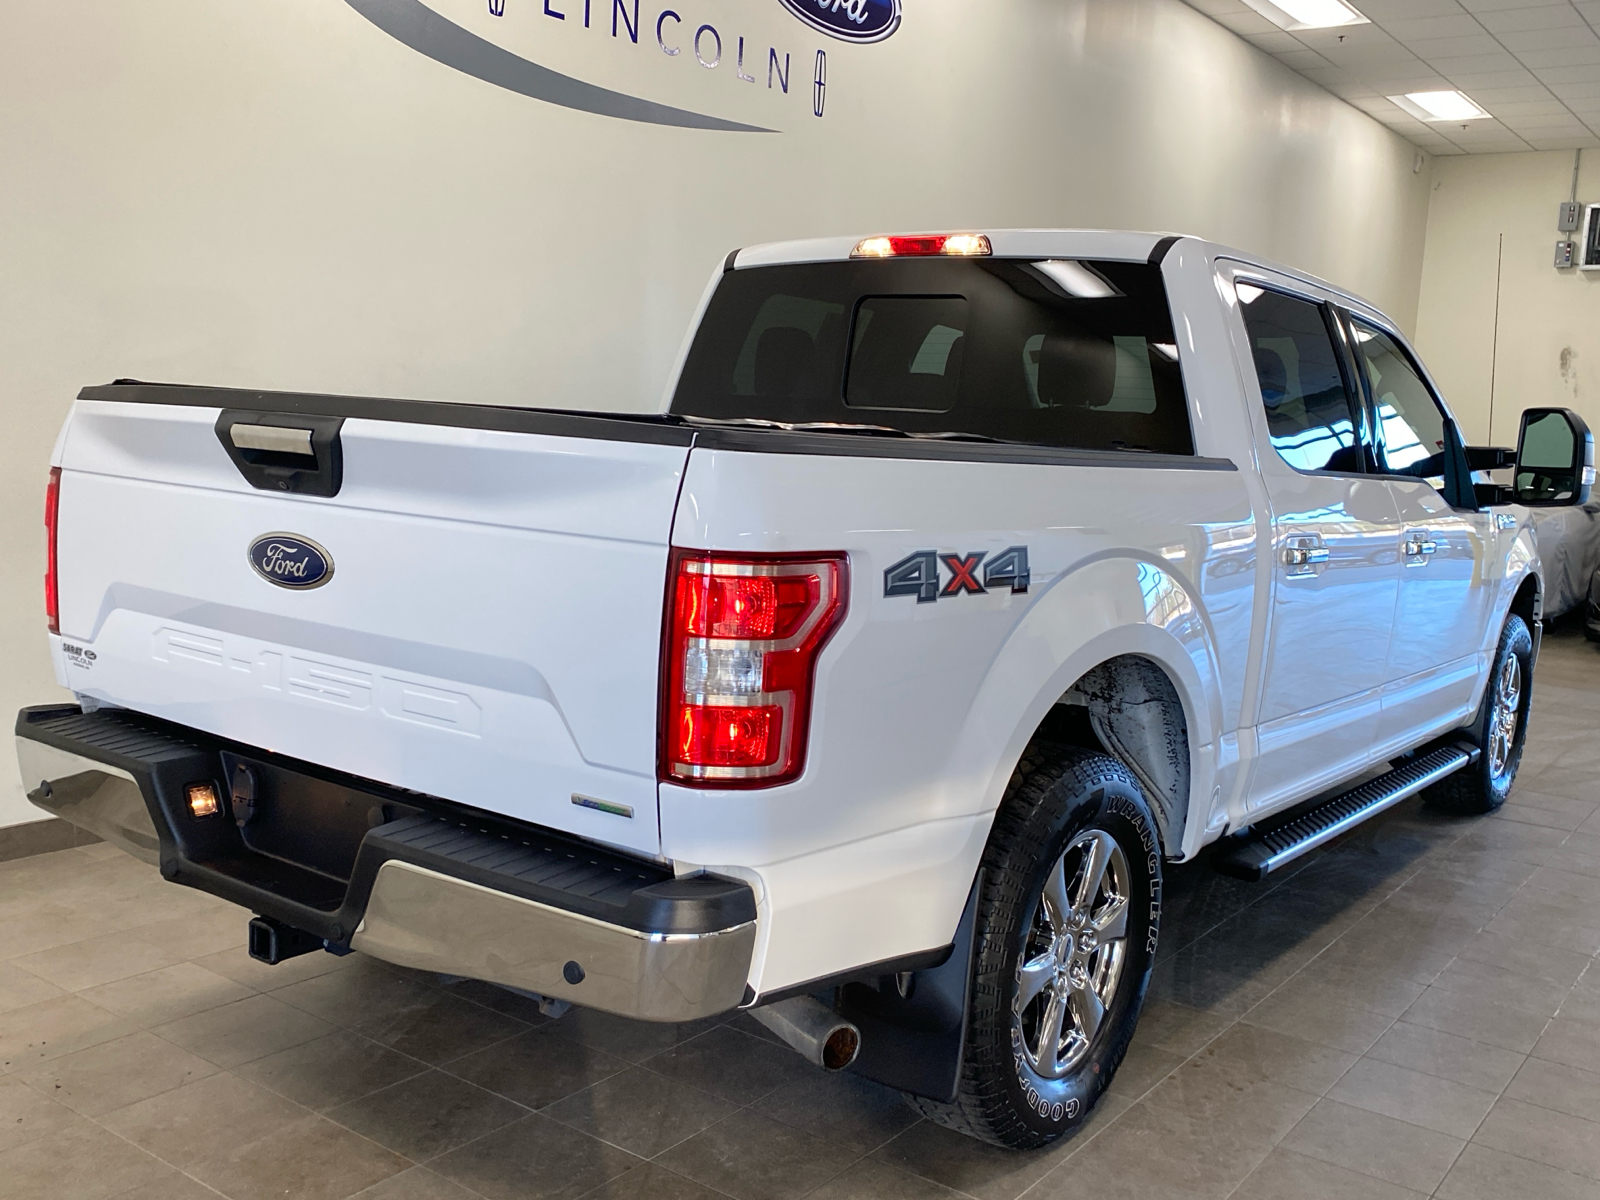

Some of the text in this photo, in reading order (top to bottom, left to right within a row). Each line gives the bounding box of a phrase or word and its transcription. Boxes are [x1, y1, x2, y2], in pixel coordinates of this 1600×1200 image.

[262, 543, 309, 577] Ford
[152, 626, 483, 739] F-150
[1106, 795, 1160, 954] WRANGLER
